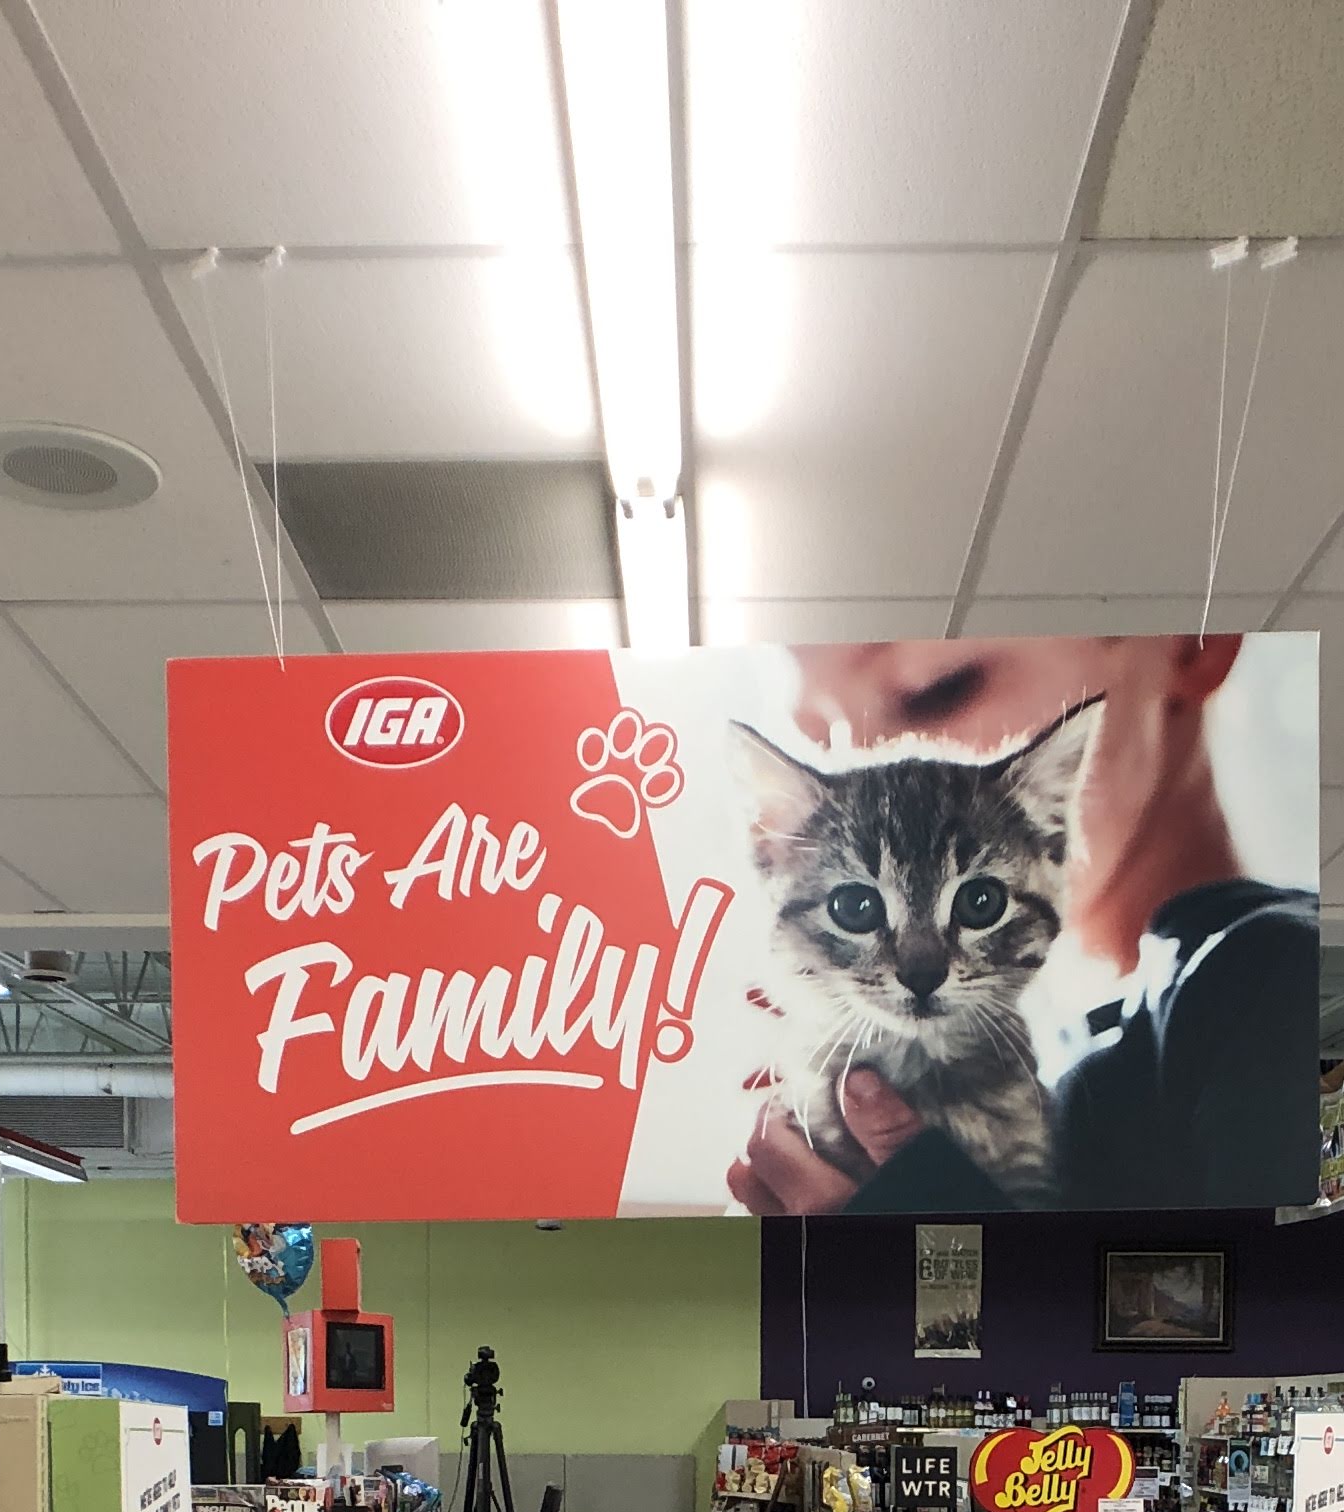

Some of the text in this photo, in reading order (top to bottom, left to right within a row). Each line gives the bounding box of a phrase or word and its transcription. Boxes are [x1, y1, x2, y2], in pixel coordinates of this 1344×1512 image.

[343, 696, 449, 746] IGA
[192, 802, 548, 931] Pets Are
[244, 877, 736, 1093] Family!
[902, 1458, 950, 1475] LIFE
[1020, 1441, 1093, 1477] Jelly
[902, 1480, 950, 1497] WTR
[995, 1471, 1078, 1509] Belly
